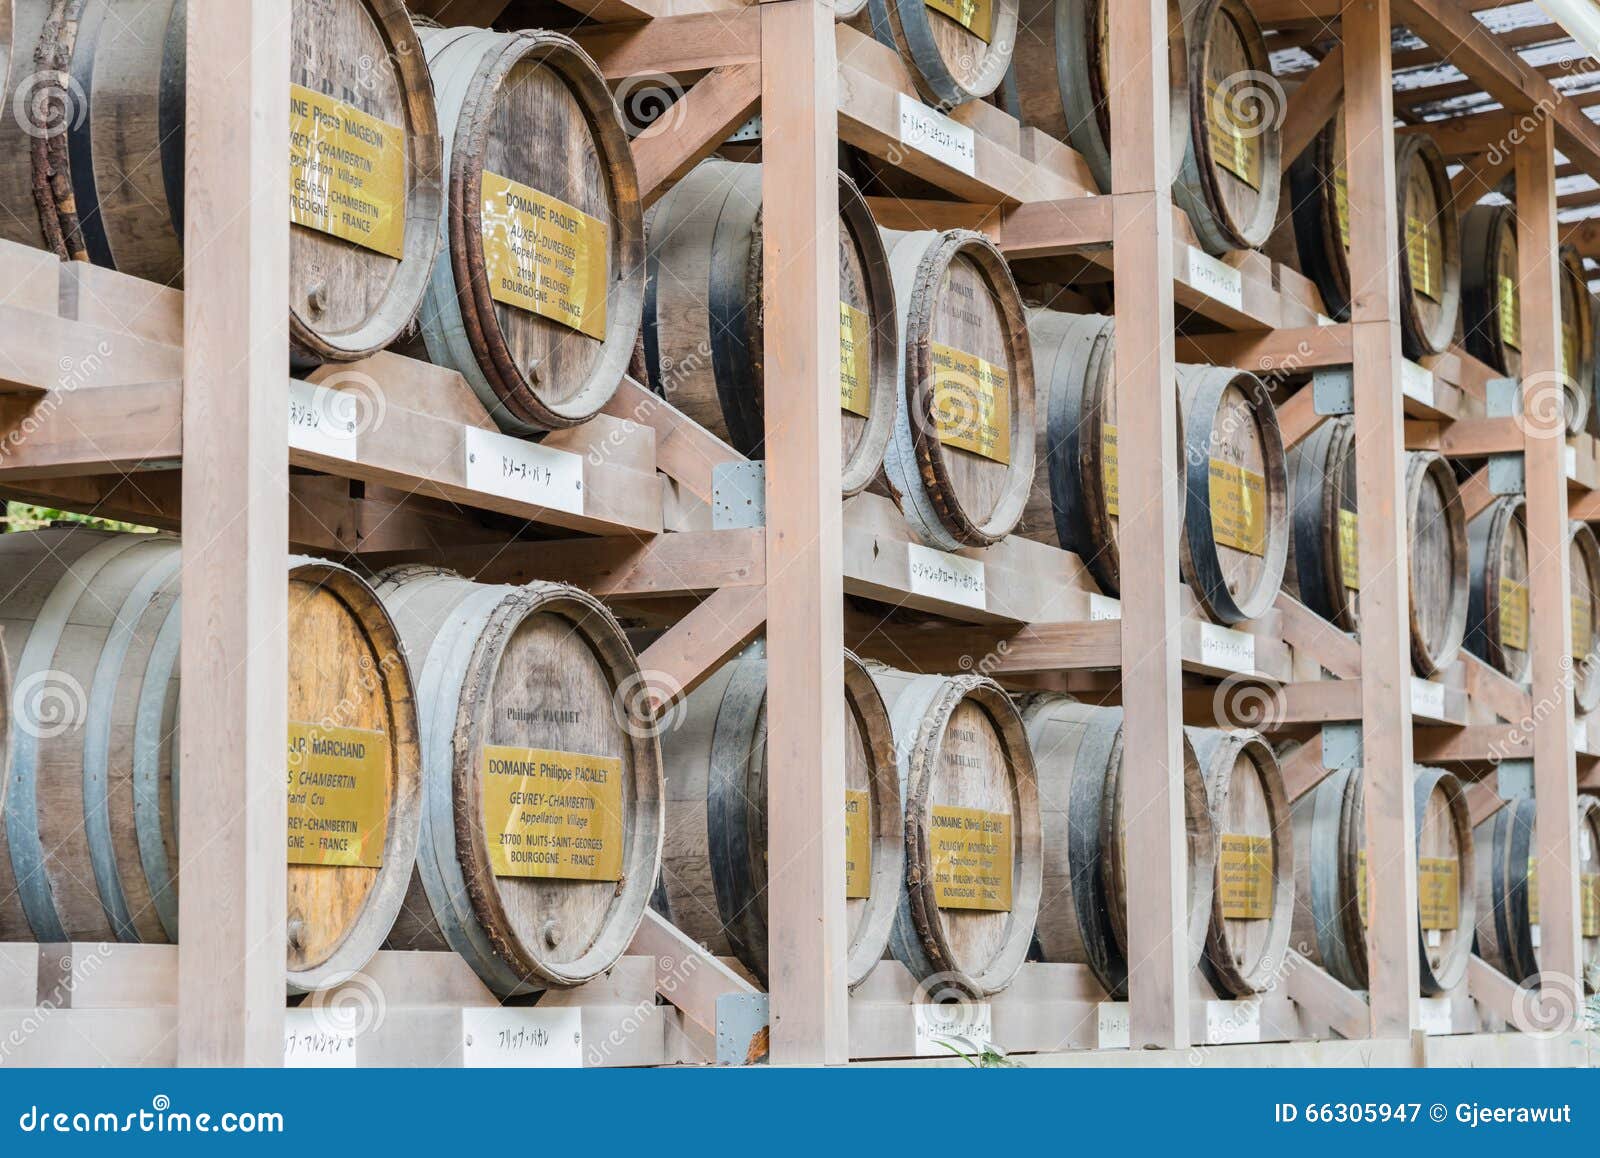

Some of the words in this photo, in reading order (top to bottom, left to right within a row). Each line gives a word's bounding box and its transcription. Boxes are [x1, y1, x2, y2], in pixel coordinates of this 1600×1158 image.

[344, 118, 383, 149] NAIGEON
[338, 168, 364, 188] Village
[342, 212, 371, 233] FRANCE
[506, 192, 546, 220] DOMAINE
[549, 209, 579, 235] PAQUET
[510, 224, 576, 261] AUXEY-DURESSES
[511, 243, 551, 265] Appellation
[555, 259, 576, 277] Village
[516, 266, 537, 281] 21190
[540, 275, 571, 296] MELOISEY
[502, 278, 548, 304] BOURGOGNE
[558, 299, 582, 318] FRANCE
[507, 707, 540, 723] Philippe
[543, 709, 580, 724] PACALET
[312, 739, 366, 760] MARCHAND
[299, 771, 356, 789] CHAMBERTIN
[489, 759, 536, 777] DOMAINE
[540, 763, 572, 781] Philippe
[575, 766, 609, 784] PACALET
[311, 792, 325, 806] Cru
[509, 791, 596, 810] GEVREY-CHAMBERTIN
[520, 811, 563, 826] Appellation
[567, 814, 588, 829] Village
[932, 815, 962, 829] DOMAINE
[319, 837, 348, 851] FRANCE
[499, 833, 522, 846] 21700
[526, 834, 603, 850] NUITS-SAINT-GEORGES
[511, 851, 560, 864] BOURGOGNE
[570, 854, 595, 866] FRANCE
